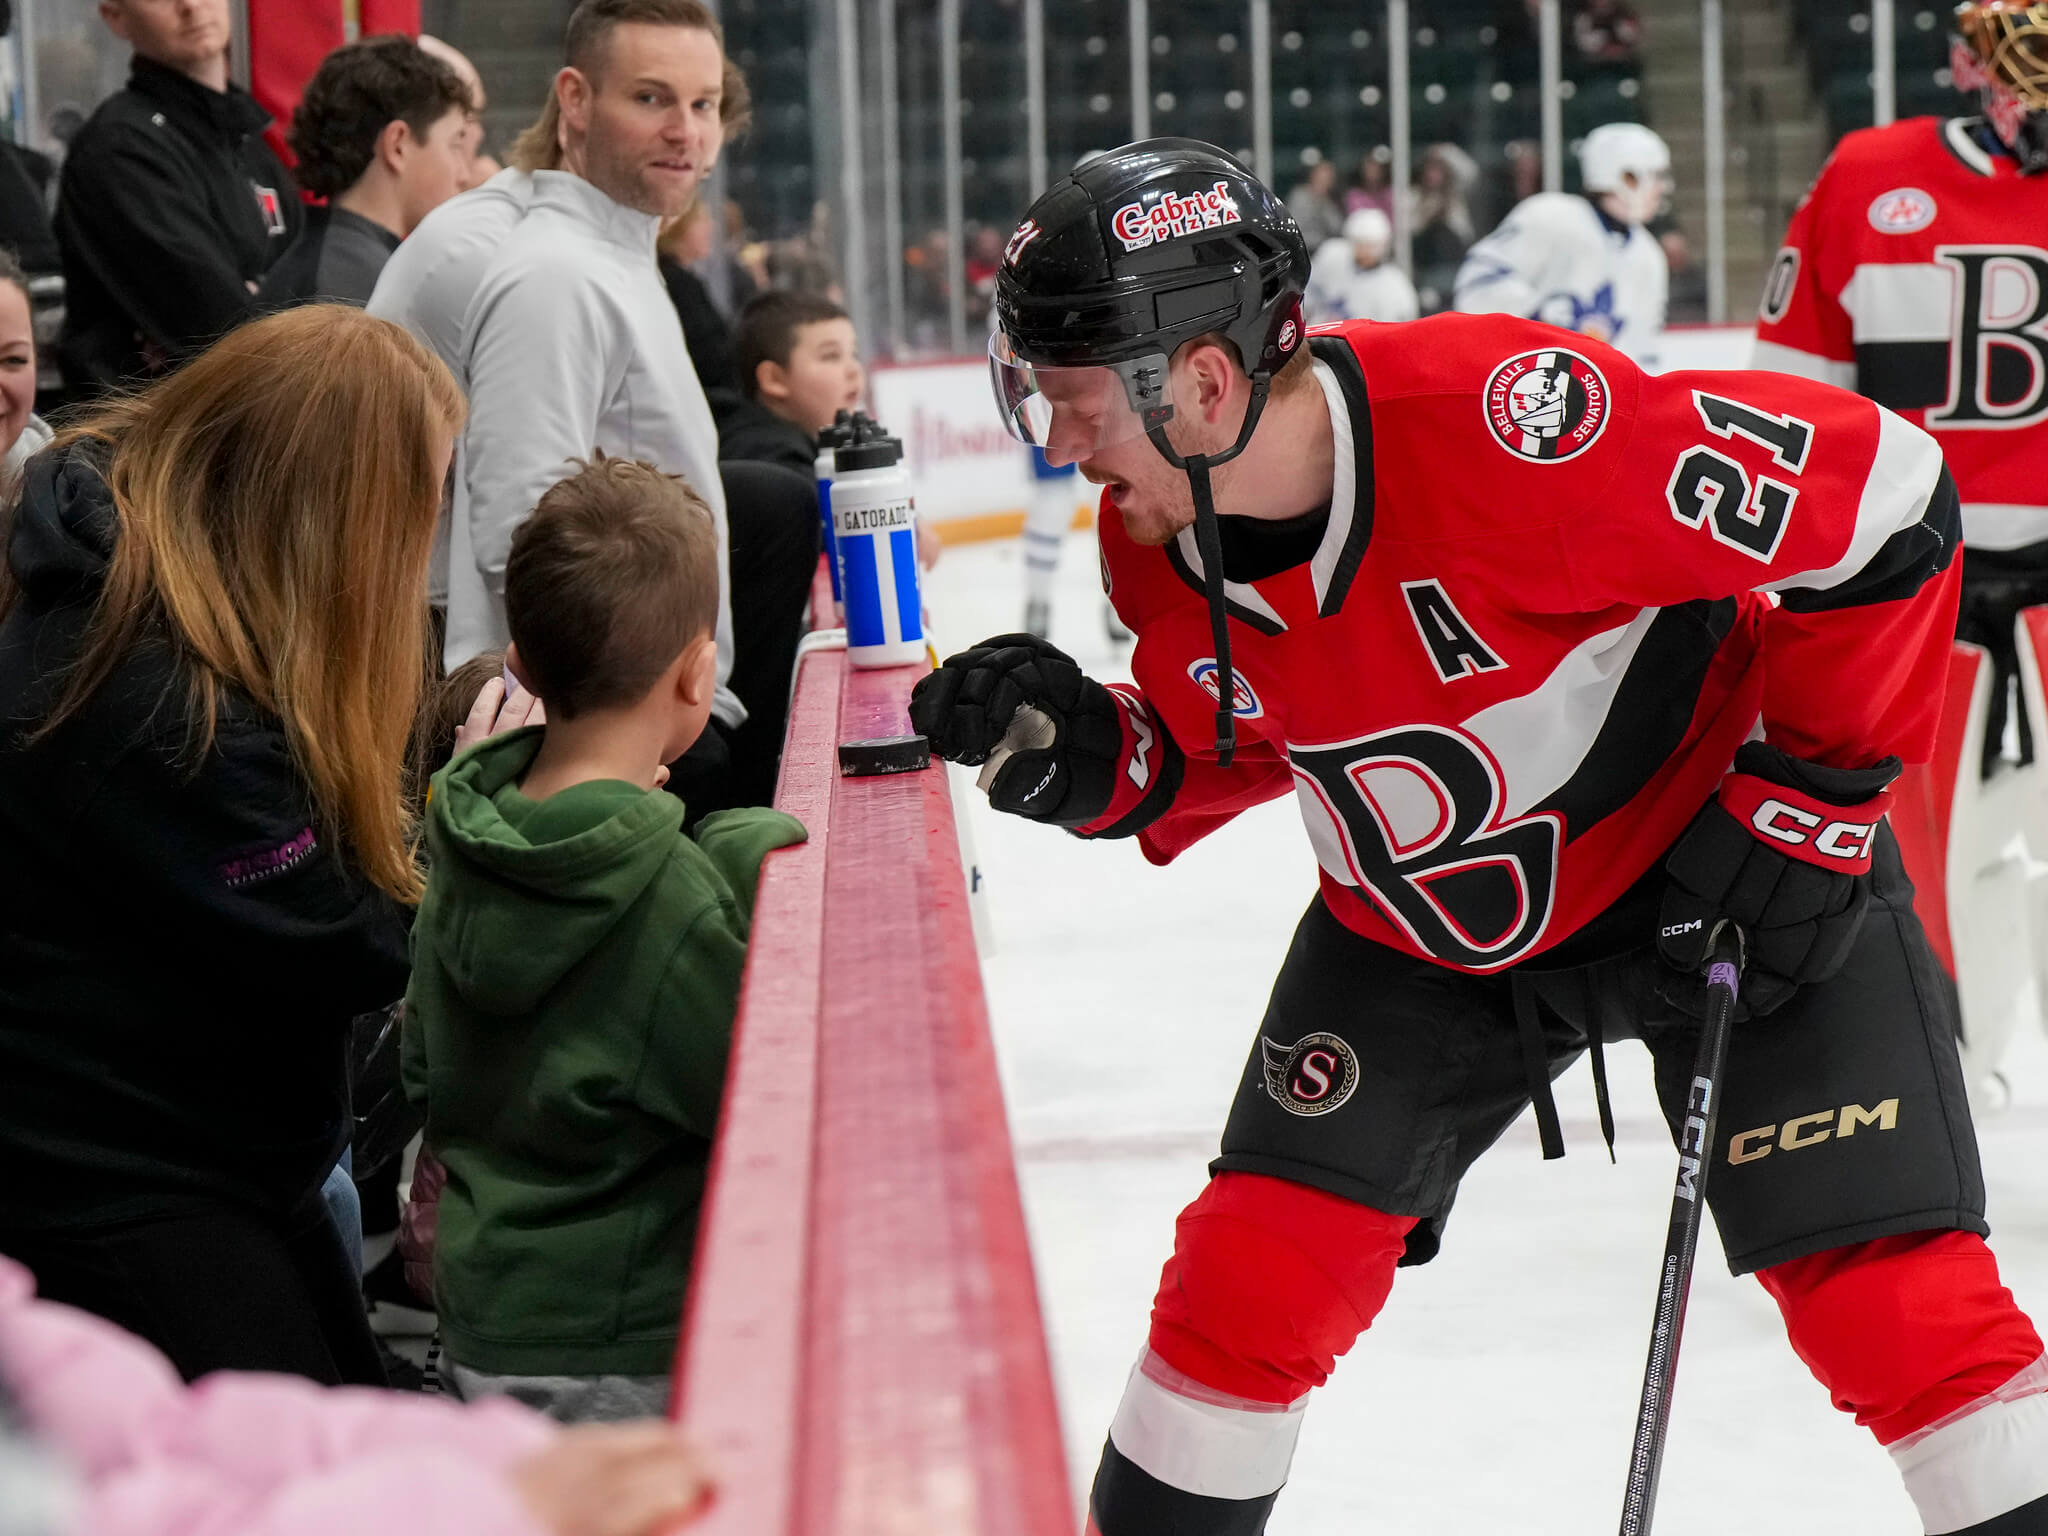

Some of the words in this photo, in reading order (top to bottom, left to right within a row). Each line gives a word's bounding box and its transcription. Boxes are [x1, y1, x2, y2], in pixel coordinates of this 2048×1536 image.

[1114, 182, 1234, 241] Gabriel
[1156, 209, 1238, 240] PIZZA
[1492, 361, 1526, 437] BELLEVILLE
[1572, 373, 1601, 442] SENATORS
[1665, 389, 1816, 566] 21
[844, 506, 908, 531] GATORADE
[1400, 577, 1510, 685] A
[1286, 724, 1567, 976] B
[1662, 919, 1703, 937] CCM
[1292, 1050, 1338, 1101] S
[1675, 1075, 1713, 1202] CCM
[1728, 1098, 1900, 1166] CCM
[1662, 1254, 1678, 1300] GUENETTE
